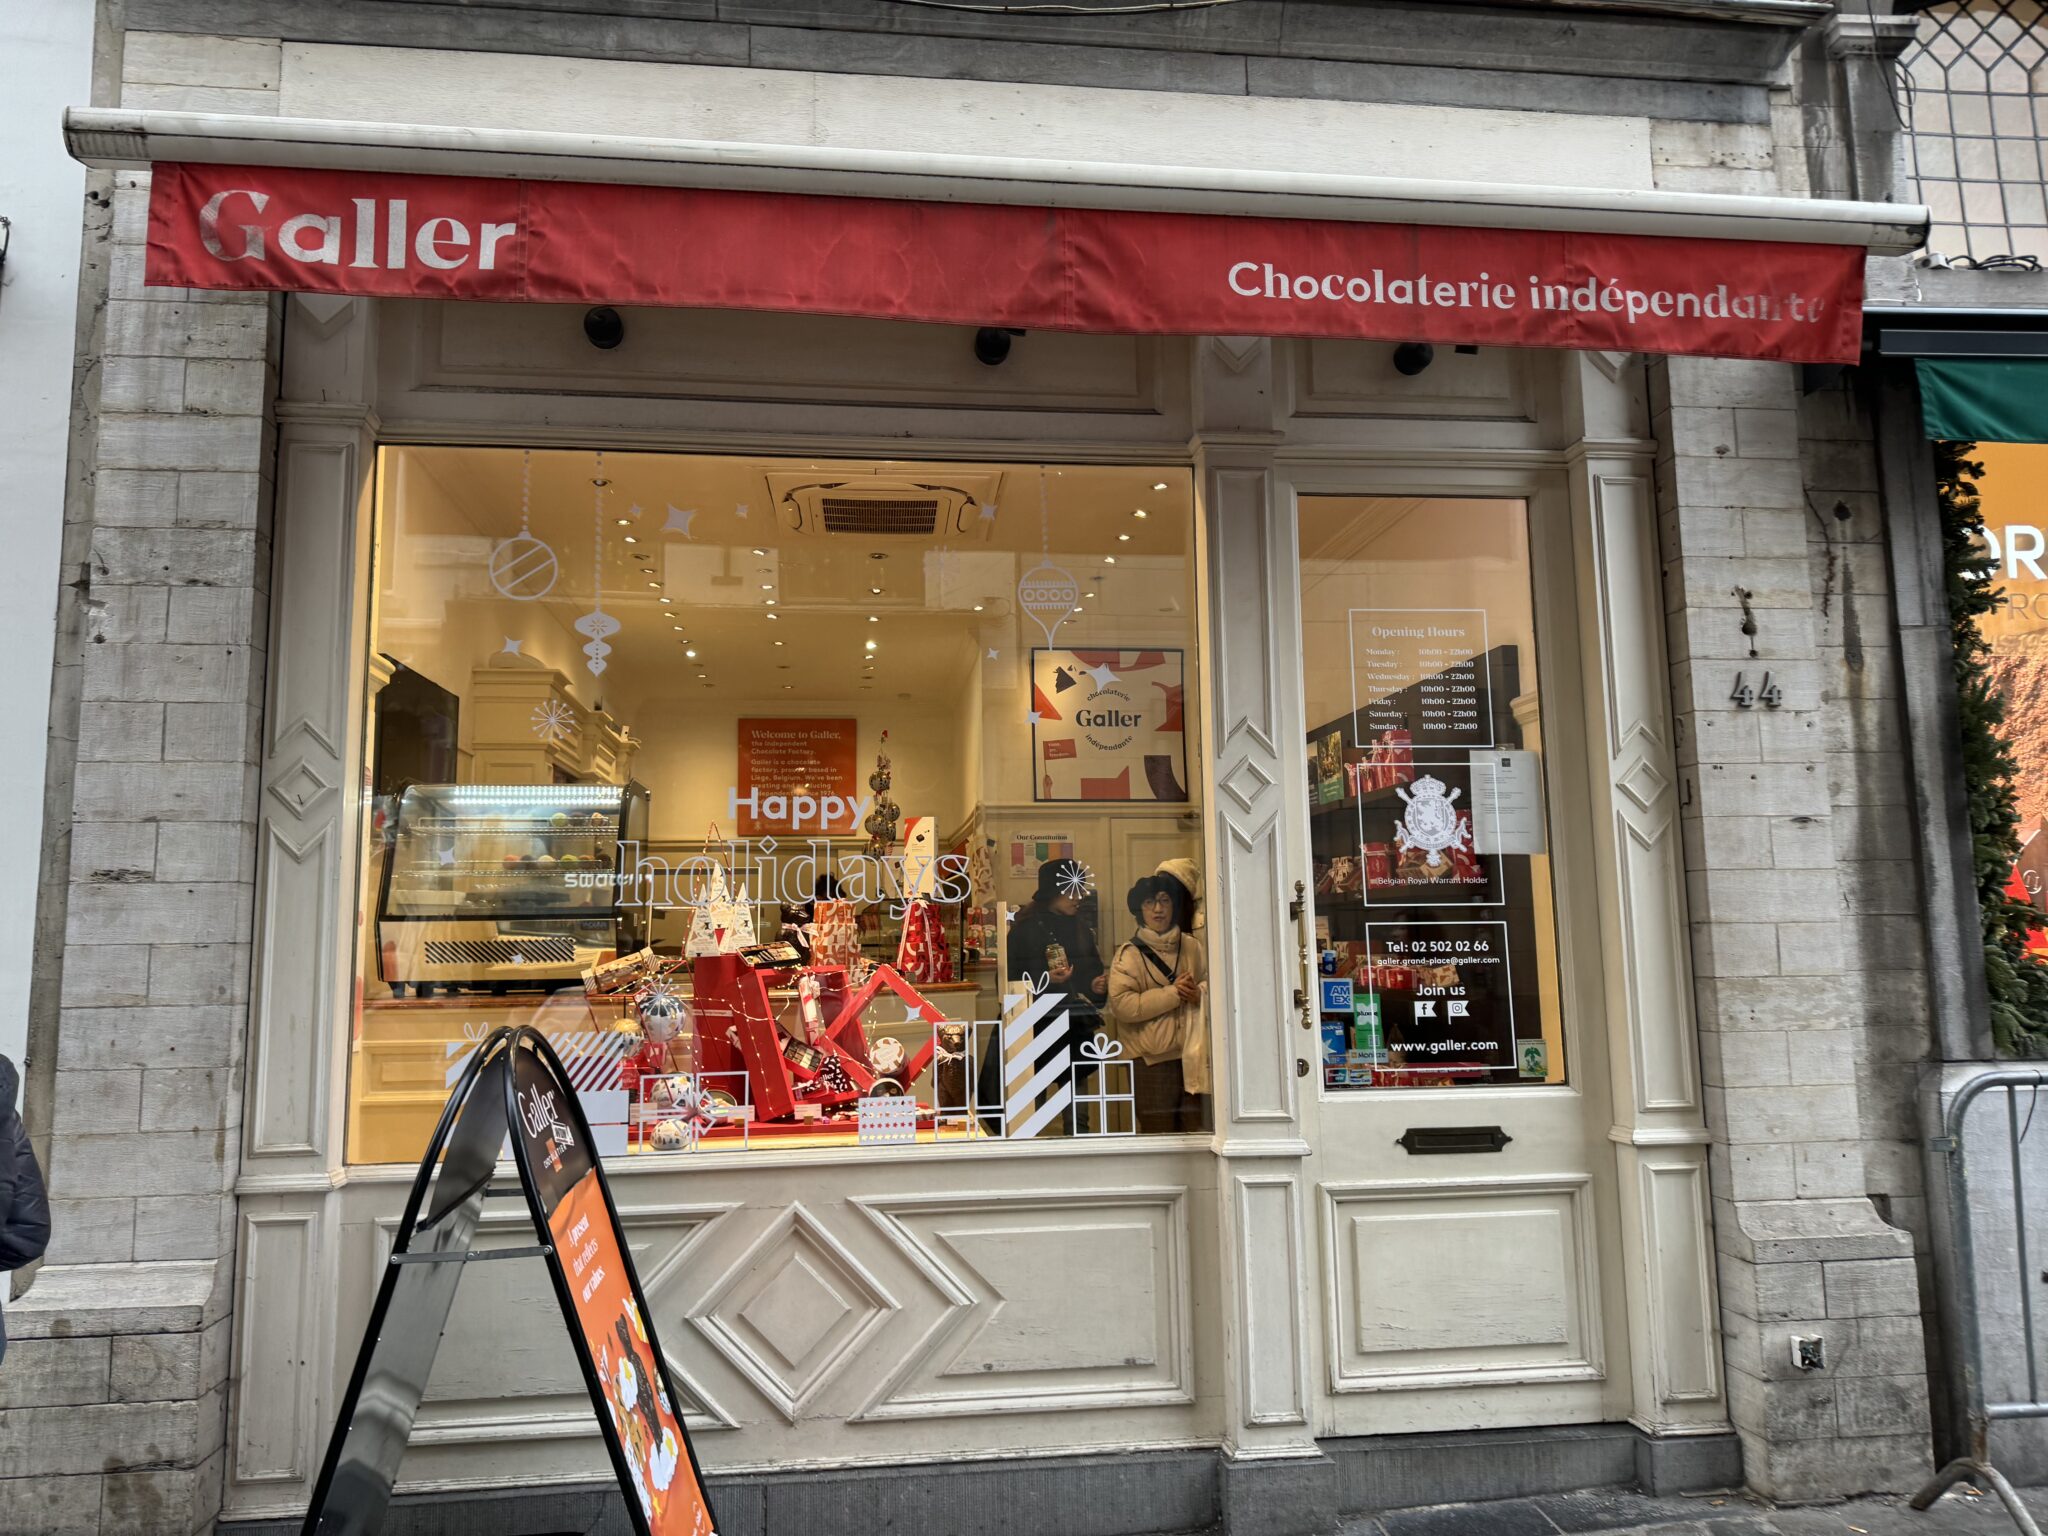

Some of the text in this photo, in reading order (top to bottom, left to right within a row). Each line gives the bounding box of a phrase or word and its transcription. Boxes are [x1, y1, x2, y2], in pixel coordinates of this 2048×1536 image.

[199, 189, 517, 270] Galler
[1228, 261, 1515, 310] Chocolaterie
[1371, 626, 1466, 638] Opening Hours
[1087, 689, 1131, 702] chocolaterie
[1730, 671, 1782, 707] 44
[1075, 709, 1141, 727] Galler
[751, 730, 795, 739] Welcome
[798, 731, 807, 739] to
[728, 787, 870, 830] Happy
[615, 835, 972, 921] holidays
[1407, 876, 1428, 886] Royal
[1430, 876, 1461, 884] Warrant
[1463, 876, 1488, 884] Holder
[1386, 940, 1489, 953] Tel: 02 502 02 66
[1377, 956, 1500, 966] galler.grand-place@galler.com
[1416, 984, 1466, 997] Join us
[1391, 1040, 1499, 1054] www.galler.com
[517, 1083, 559, 1139] Galler
